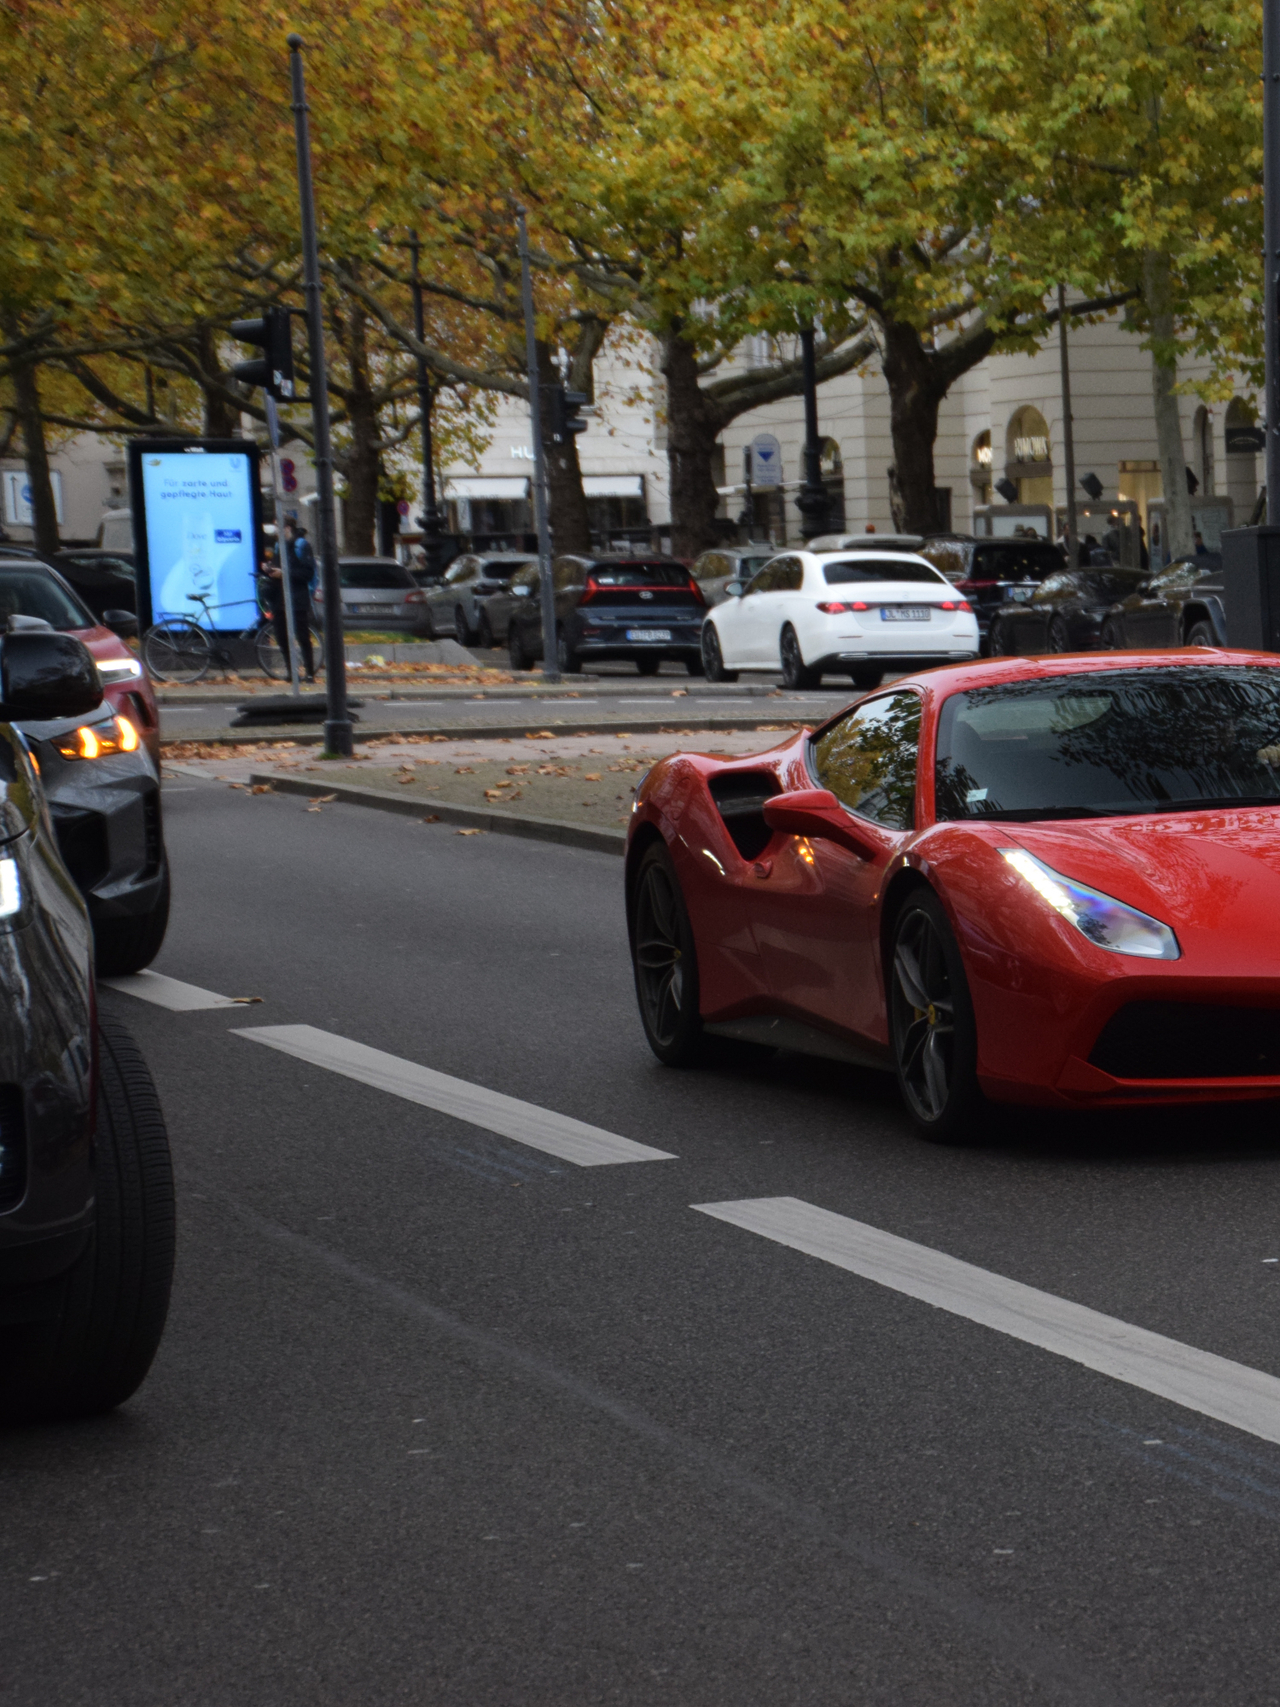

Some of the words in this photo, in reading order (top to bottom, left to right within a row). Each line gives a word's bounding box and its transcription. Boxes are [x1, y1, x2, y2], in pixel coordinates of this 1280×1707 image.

[182, 479, 207, 487] zarte
[209, 479, 228, 487] und
[160, 489, 206, 499] gepflegte
[209, 489, 232, 498] Haut
